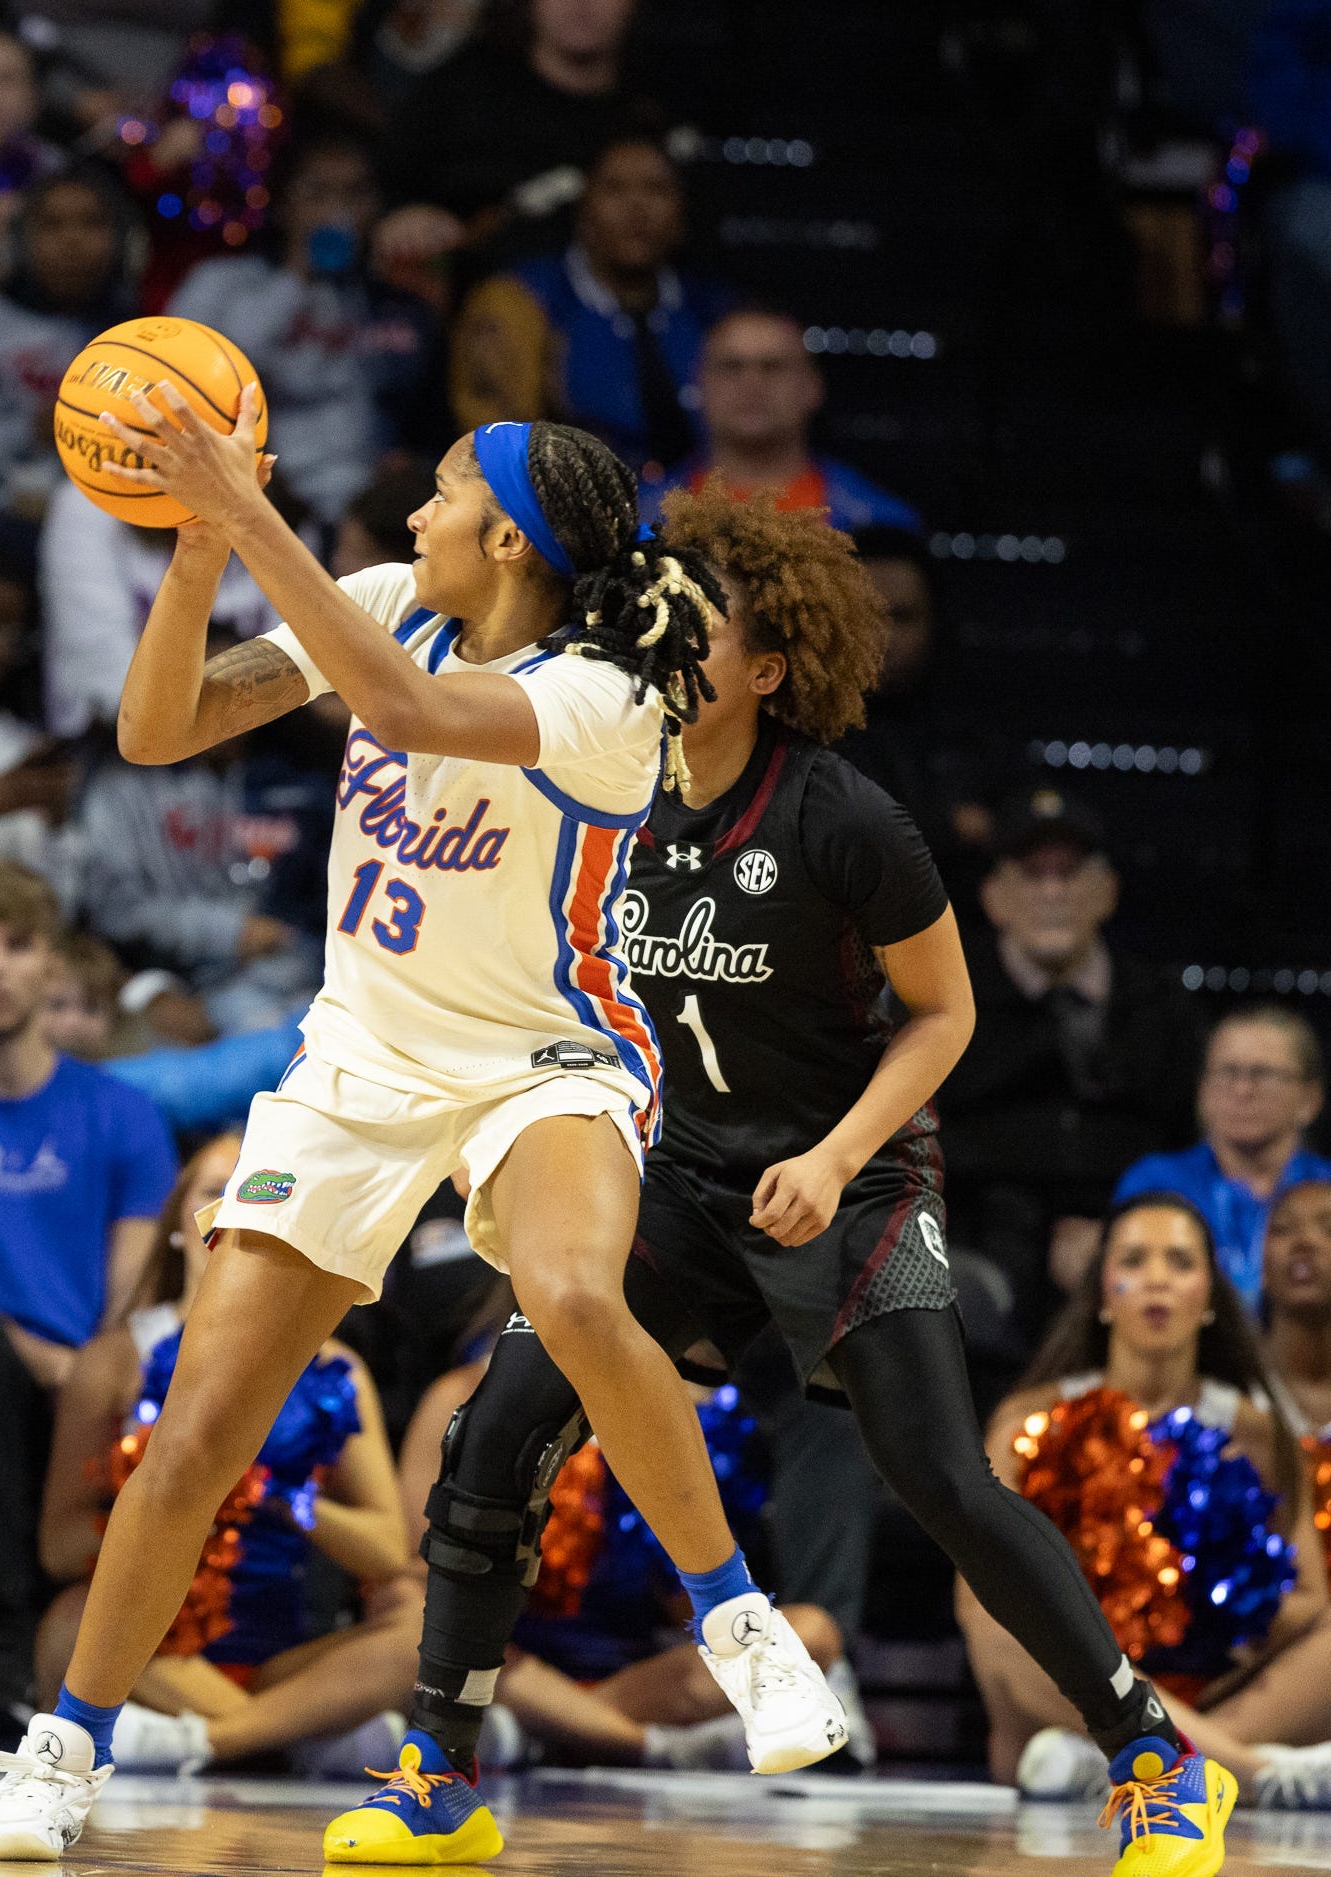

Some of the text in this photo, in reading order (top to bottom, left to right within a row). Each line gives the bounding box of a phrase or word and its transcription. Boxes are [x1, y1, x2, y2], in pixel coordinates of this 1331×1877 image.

[337, 727, 511, 872] Florida
[337, 858, 426, 956] 13
[738, 852, 775, 892] SEC
[675, 994, 732, 1093] 1
